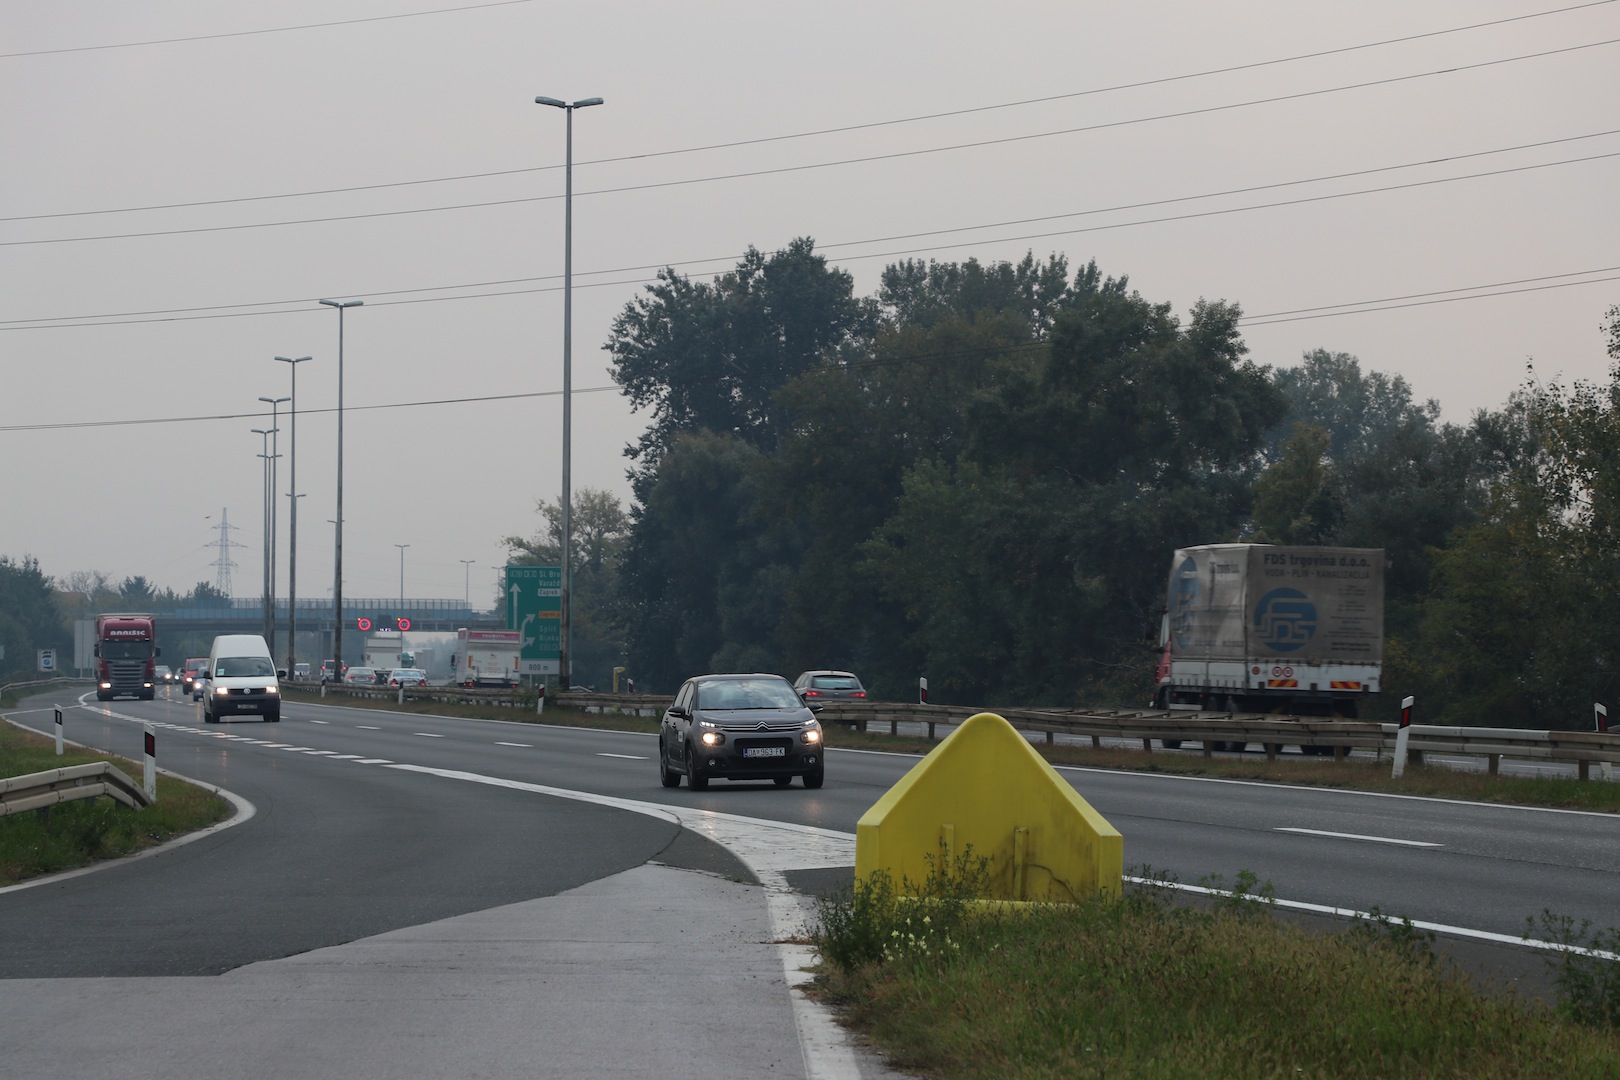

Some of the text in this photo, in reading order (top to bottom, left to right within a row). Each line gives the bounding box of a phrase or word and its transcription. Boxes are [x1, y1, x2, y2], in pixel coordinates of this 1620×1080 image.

[1264, 553, 1370, 568] FDS trgovina d.o.o.
[549, 570, 560, 578] Bro
[528, 663, 541, 671] 800
